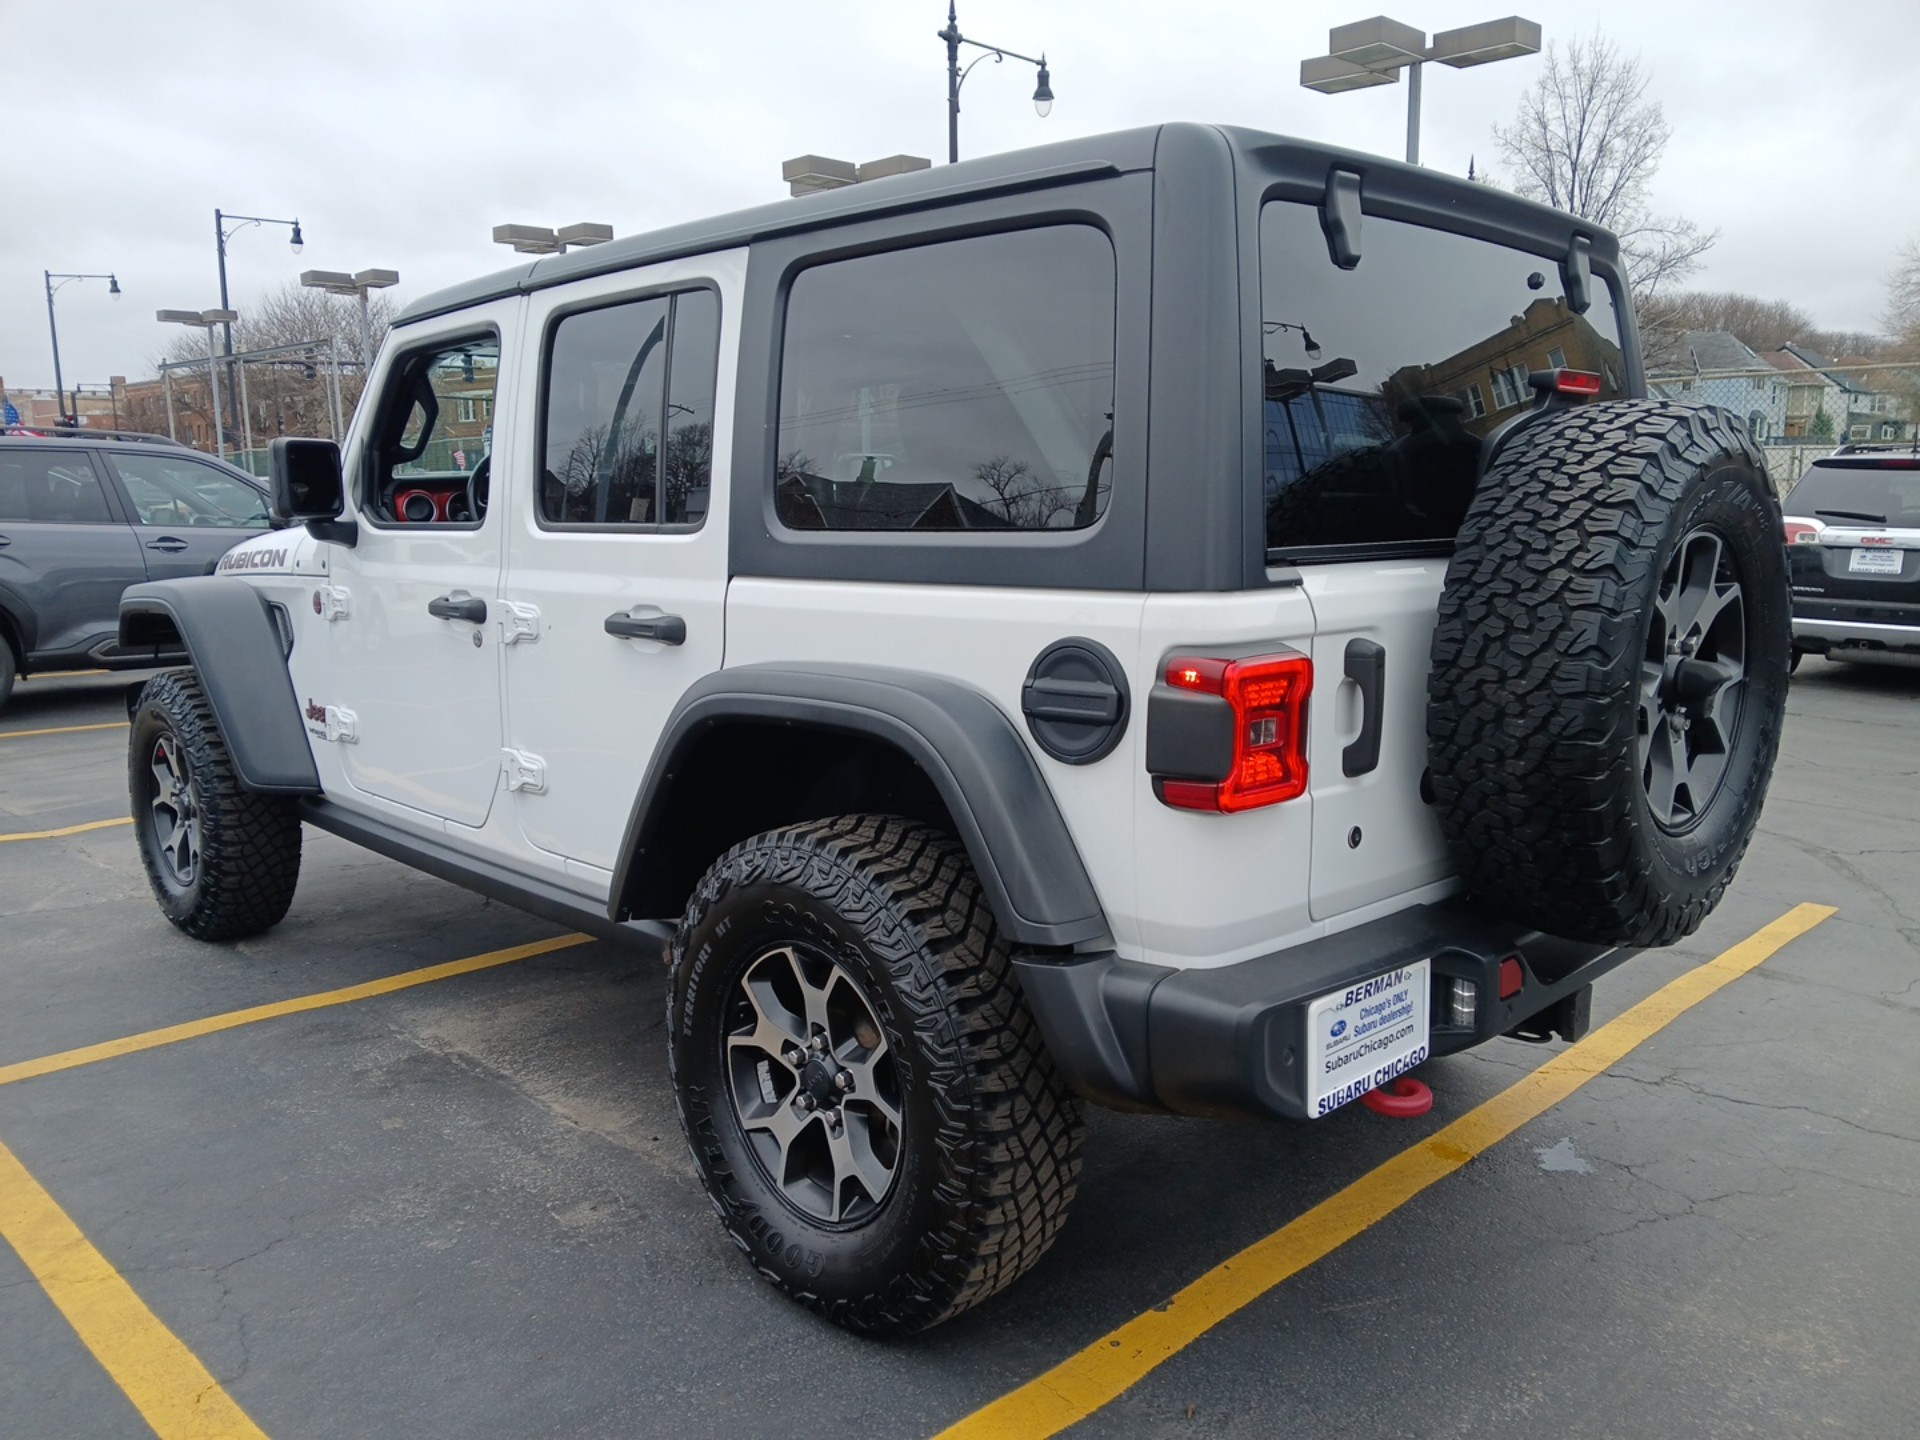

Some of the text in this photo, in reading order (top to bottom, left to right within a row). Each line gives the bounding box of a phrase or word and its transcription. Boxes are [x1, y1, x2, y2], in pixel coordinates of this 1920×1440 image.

[218, 548, 289, 571] RUBICON
[1860, 536, 1894, 545] GMC
[683, 941, 712, 1036] TERRITORY
[1344, 968, 1404, 1008] BERMAN
[1360, 989, 1409, 1020] Chicago's ONLY
[1354, 1001, 1414, 1037] Subaru dealership!
[1324, 1024, 1415, 1074] SubaruChicago.com
[1318, 1046, 1426, 1115] SUBARU CHICAGO
[689, 1085, 825, 1278] GOODYEAR
